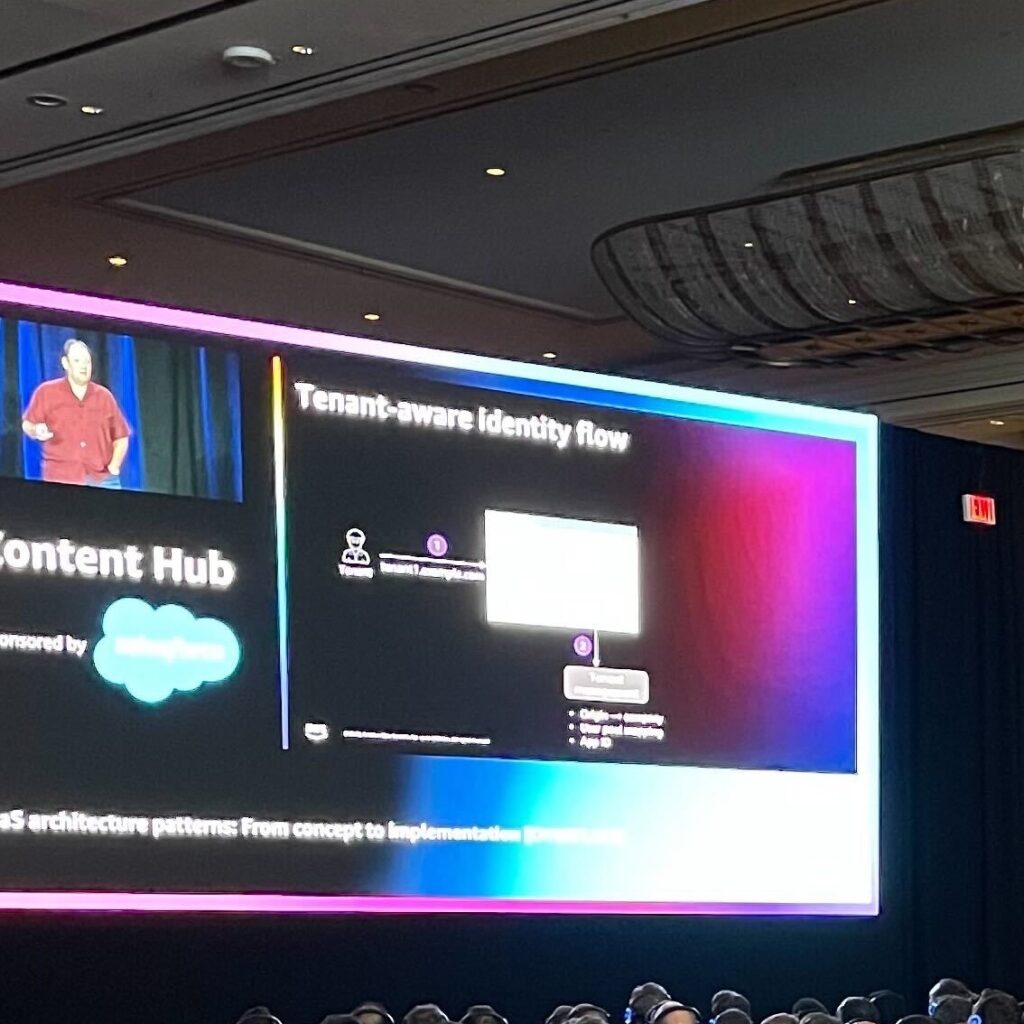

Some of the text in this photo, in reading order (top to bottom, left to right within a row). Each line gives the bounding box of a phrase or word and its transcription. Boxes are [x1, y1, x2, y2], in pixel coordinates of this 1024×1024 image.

[294, 381, 630, 452] Tenant-aware identity flow
[0, 530, 236, 587] ontent Hub
[65, 634, 88, 658] by
[29, 810, 149, 834] architecture
[241, 817, 290, 838] From
[292, 821, 364, 845] concept
[365, 822, 386, 840] to
[388, 821, 522, 844] implementation
